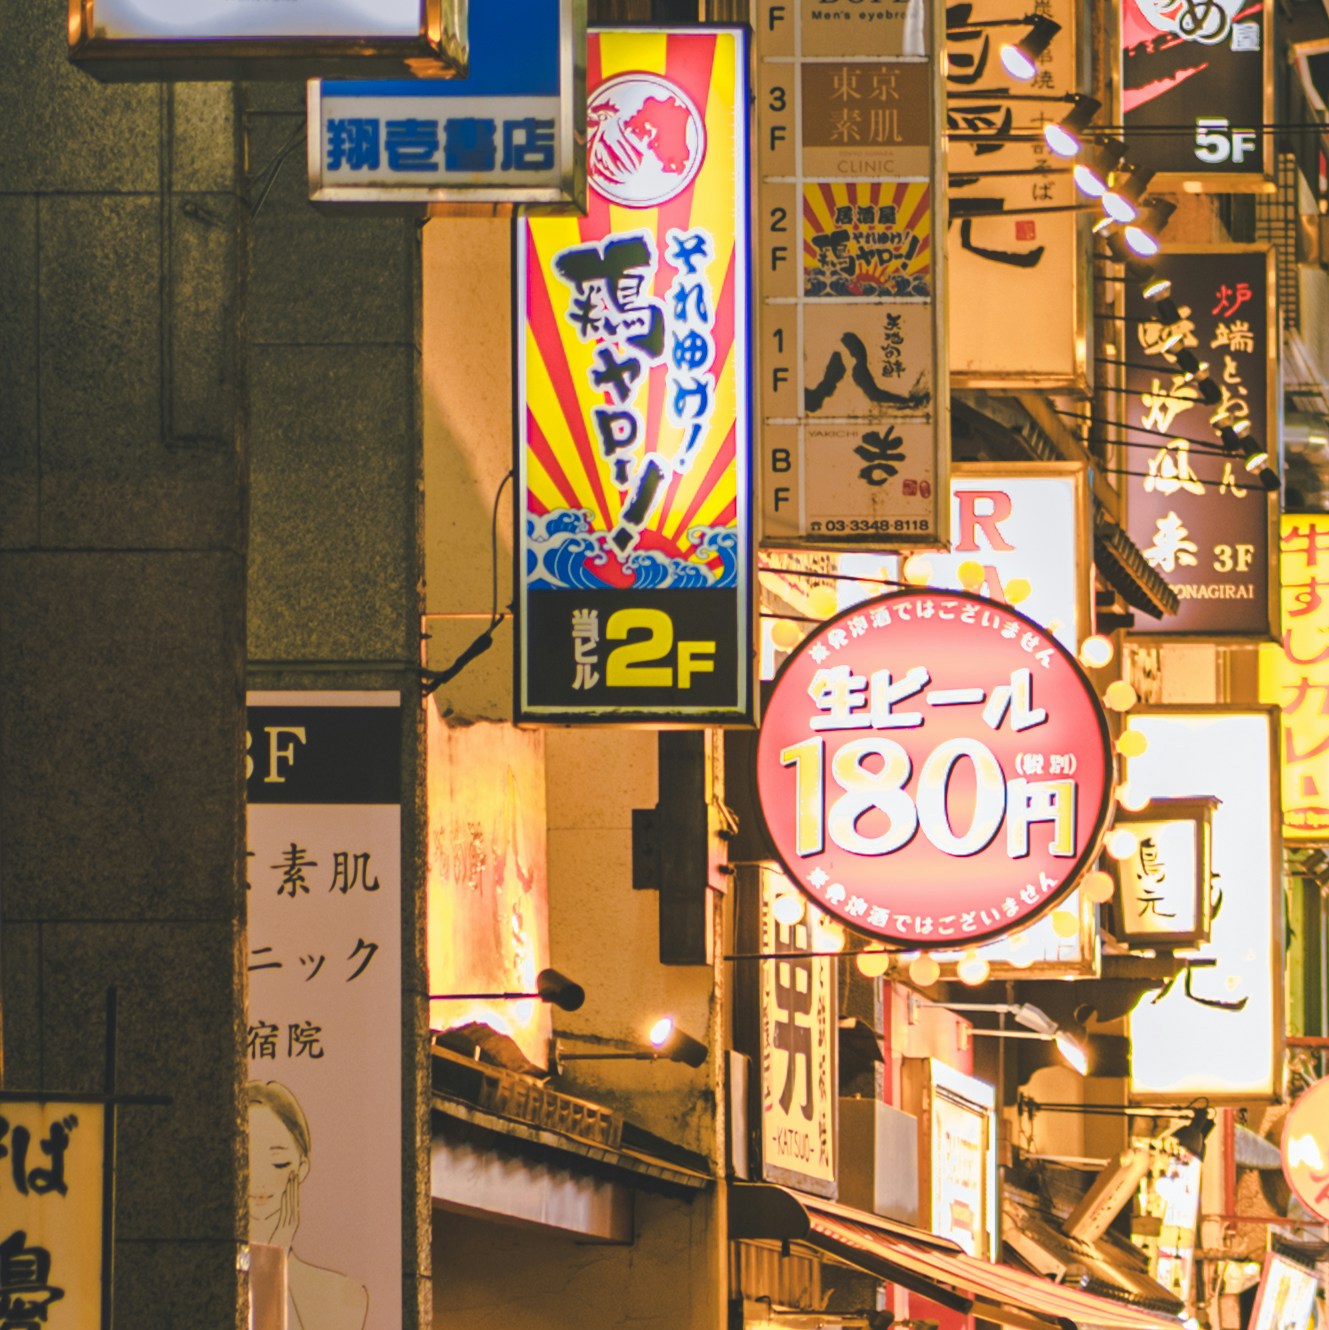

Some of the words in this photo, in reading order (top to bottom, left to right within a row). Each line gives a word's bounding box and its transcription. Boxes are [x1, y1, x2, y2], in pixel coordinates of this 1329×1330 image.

[812, 10, 851, 20] Men's
[828, 66, 901, 102] 東京
[828, 107, 903, 144] 素肌
[1194, 117, 1257, 164] 5F
[837, 160, 895, 174] CLINIC
[769, 206, 788, 271] 2F
[835, 205, 897, 225] 居酒屋
[772, 328, 789, 392] 1F
[553, 235, 666, 554] 鶏ヤロー!
[1211, 283, 1255, 498] 炉端とおん
[1213, 544, 1255, 573] 3F
[1168, 584, 1255, 600] ONAGIRAI
[571, 608, 600, 691] 当ビル
[605, 607, 717, 690] 2F
[807, 664, 1048, 732] 生ビール
[780, 735, 1077, 860] 180円
